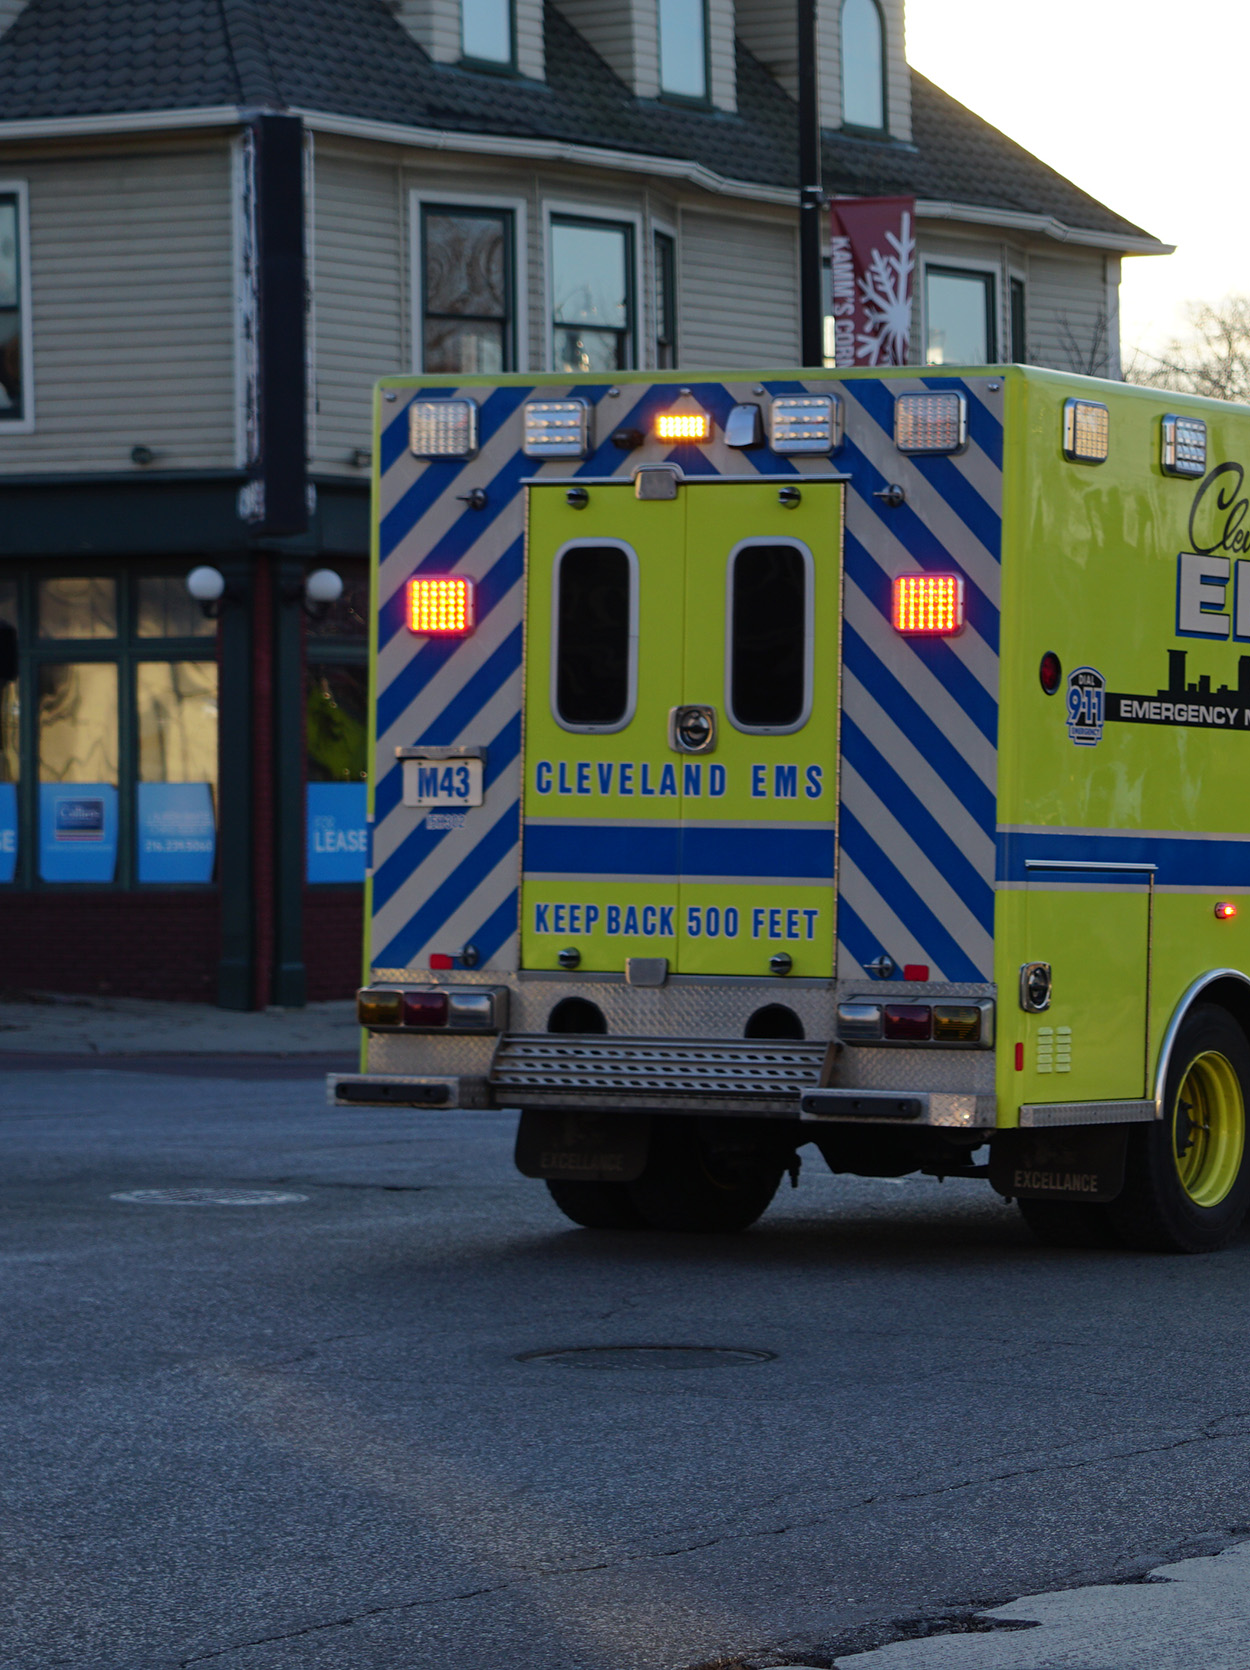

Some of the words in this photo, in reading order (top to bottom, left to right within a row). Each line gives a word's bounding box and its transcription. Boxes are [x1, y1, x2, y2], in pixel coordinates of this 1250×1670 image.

[832, 236, 855, 316] KAMM'S
[1078, 674, 1095, 686] DIAL
[1119, 700, 1238, 725] EMERGENCY
[418, 766, 470, 798] M43
[536, 760, 727, 797] CLEVELAND
[751, 764, 824, 798] EMS
[315, 830, 367, 852] LEASE
[535, 903, 599, 934] KEEP
[606, 905, 675, 936] BACK
[687, 906, 739, 938] 500
[753, 908, 819, 939] FEET
[1014, 1170, 1098, 1192] EXCELLANCE
